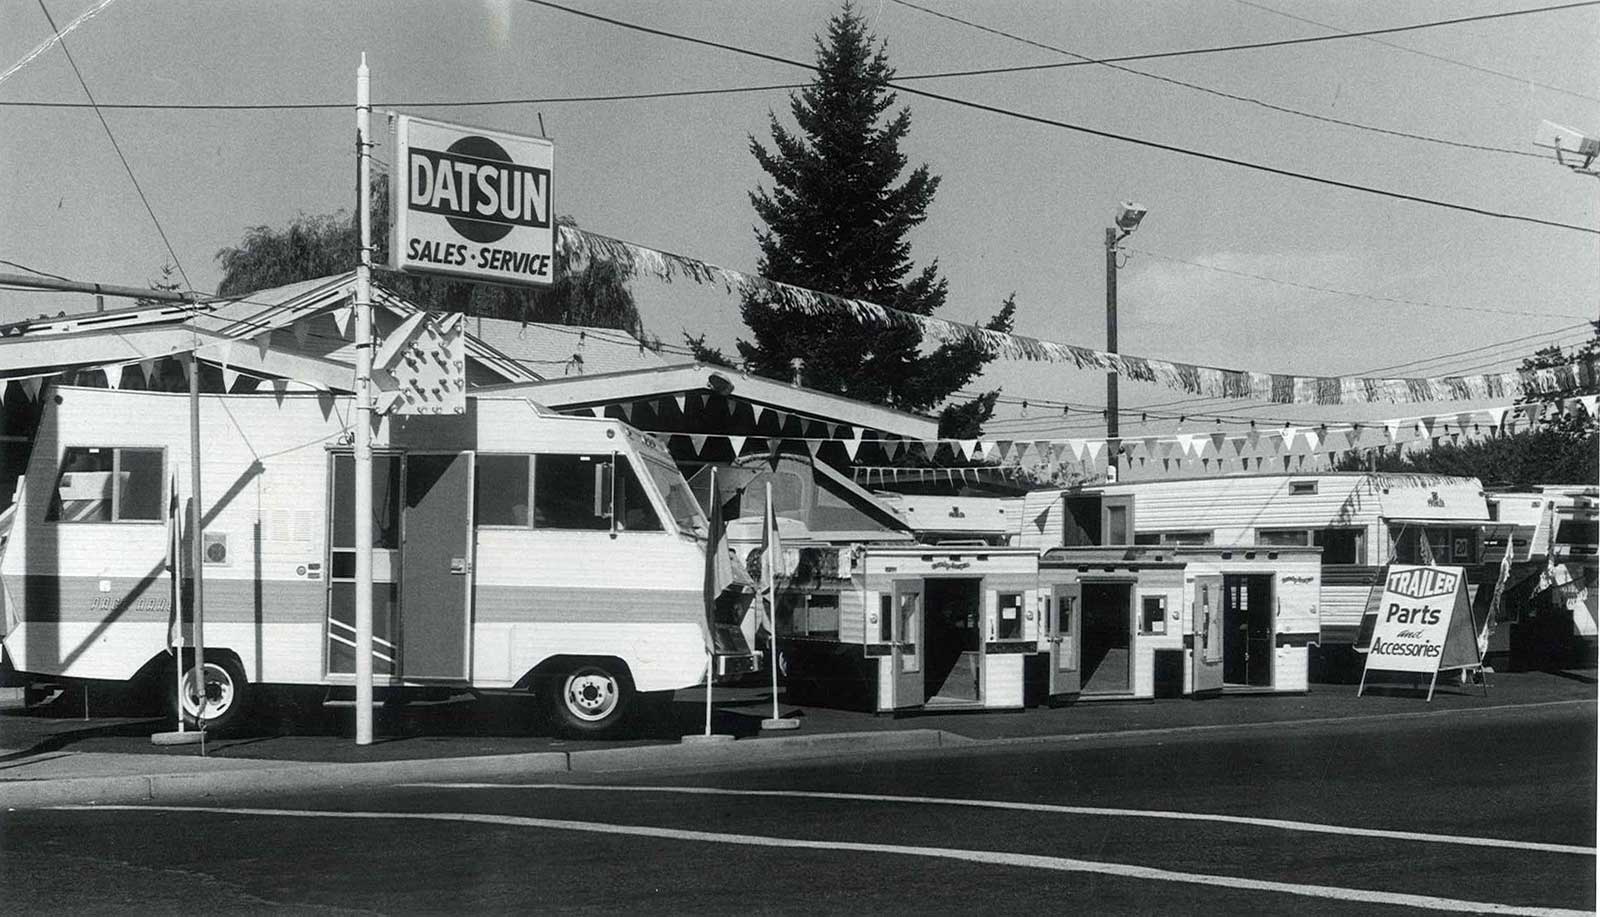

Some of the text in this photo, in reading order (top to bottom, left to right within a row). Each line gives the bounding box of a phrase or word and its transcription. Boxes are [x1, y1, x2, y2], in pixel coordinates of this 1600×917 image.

[410, 153, 547, 222] DATSUN
[407, 238, 550, 276] SALES SERVICE
[1390, 569, 1455, 597] TRAILER
[1386, 603, 1441, 625] Parts
[1396, 629, 1424, 638] and
[1371, 637, 1441, 657] Accessories
